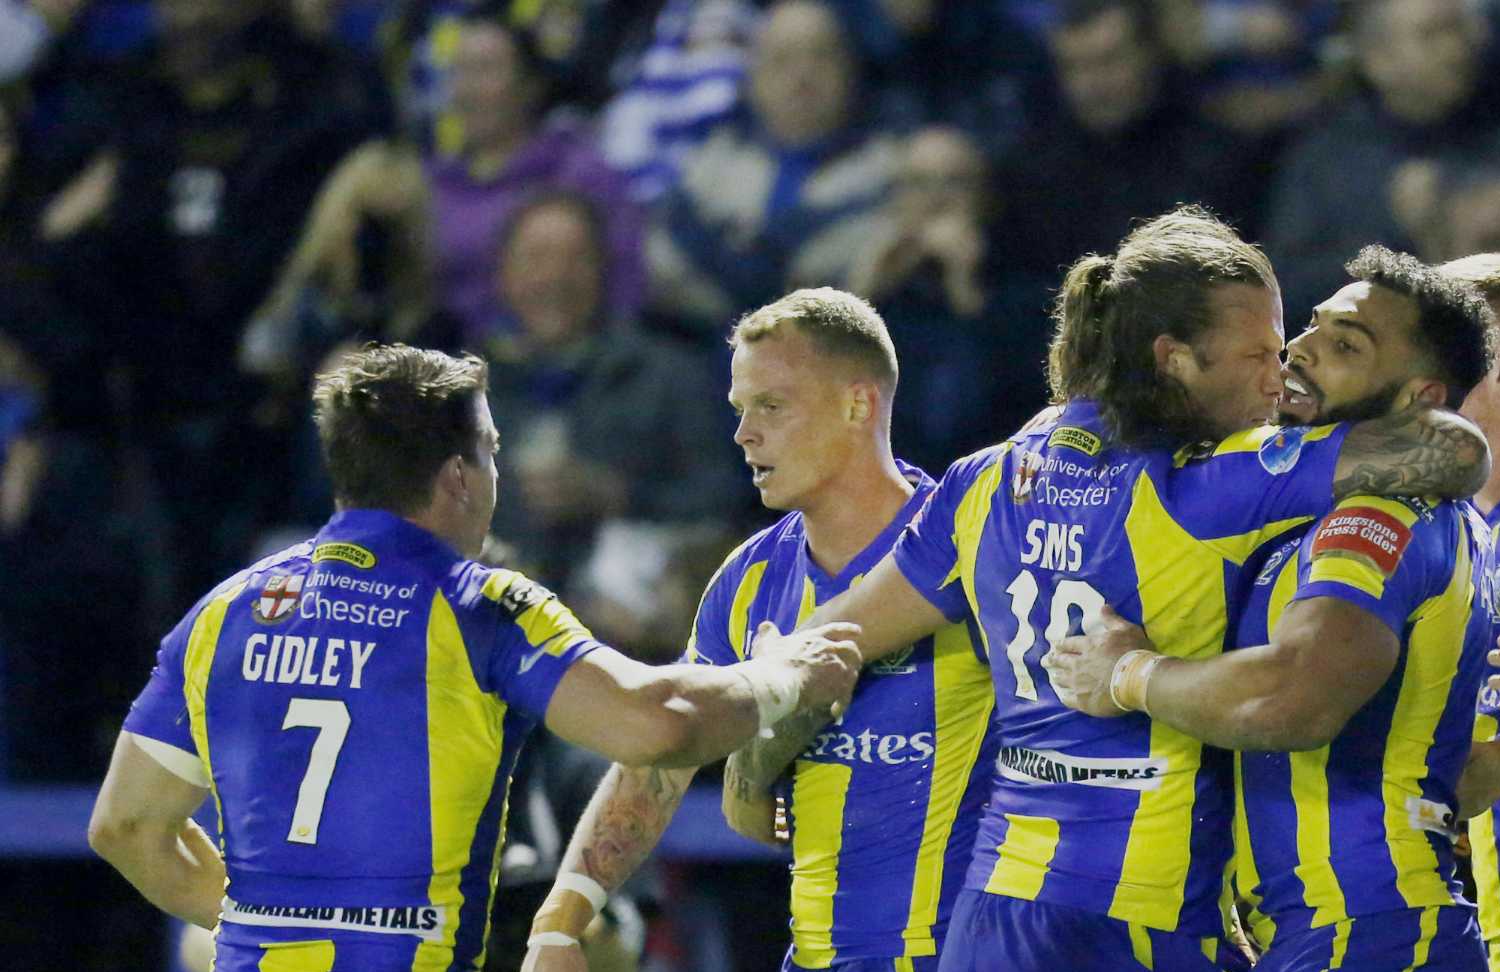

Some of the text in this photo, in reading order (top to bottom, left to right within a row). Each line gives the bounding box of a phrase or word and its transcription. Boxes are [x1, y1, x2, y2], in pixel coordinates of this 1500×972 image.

[1035, 476, 1118, 507] Chester
[1318, 525, 1398, 556] Press Cider
[1327, 515, 1399, 542] Kingstone
[305, 569, 418, 600] University of
[300, 591, 410, 628] Chester
[242, 633, 377, 690] GIDLEY
[814, 726, 936, 766] rates
[281, 697, 352, 845] 7
[1000, 748, 1068, 784] MAXILEAD
[340, 906, 438, 931] METALS
